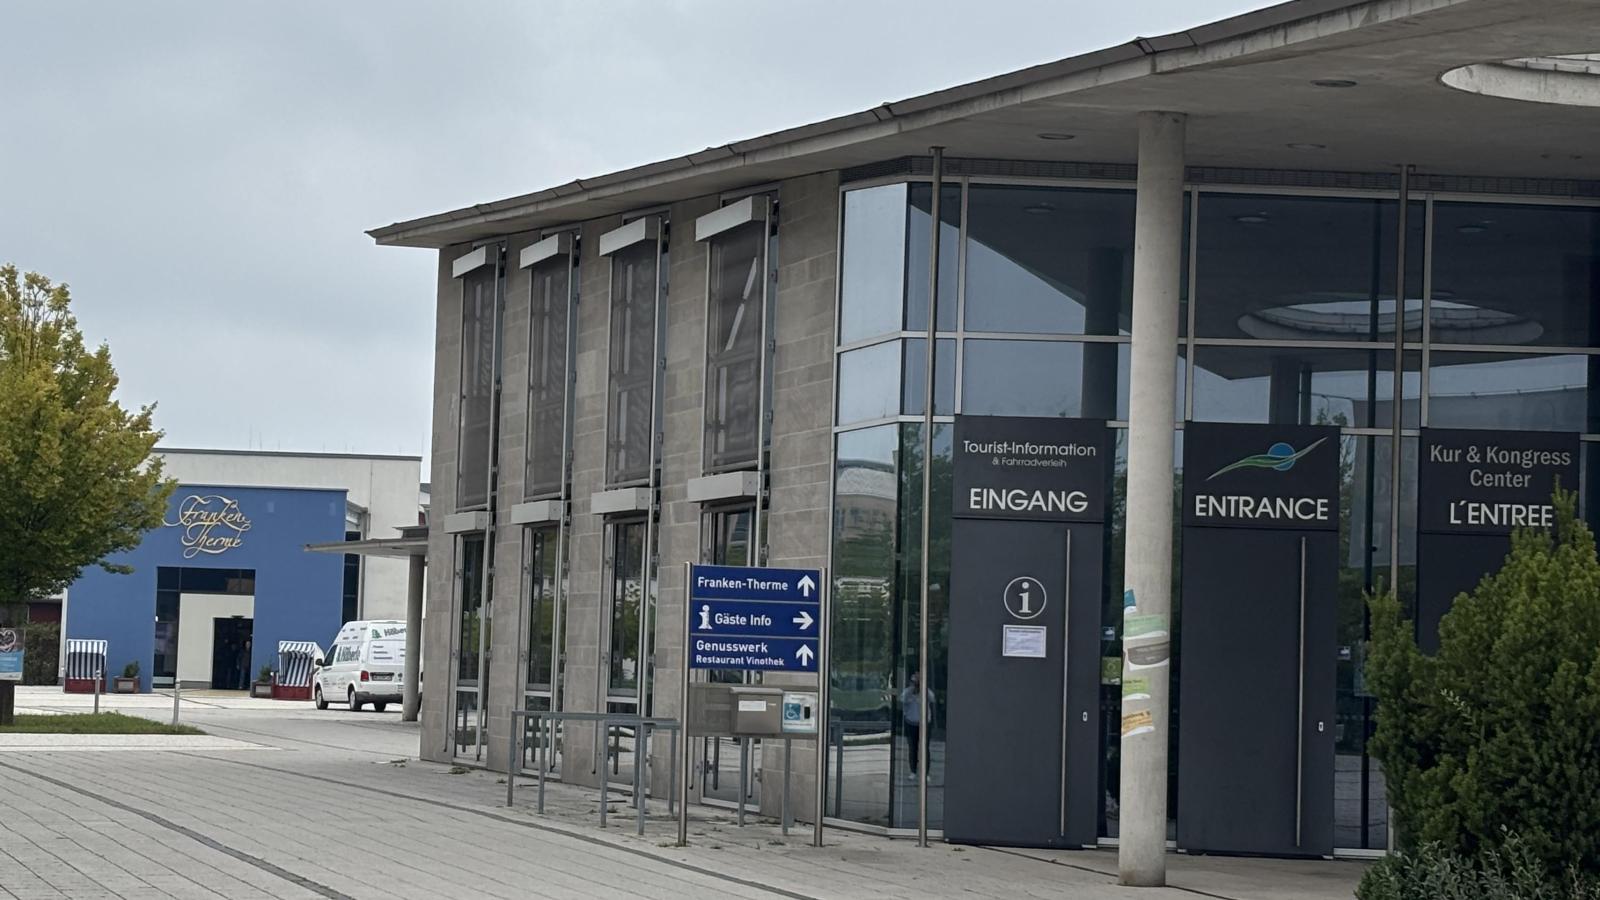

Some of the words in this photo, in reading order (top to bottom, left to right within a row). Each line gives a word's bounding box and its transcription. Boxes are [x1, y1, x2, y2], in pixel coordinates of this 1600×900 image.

[963, 440, 1096, 457] Tourist-Information
[1430, 444, 1462, 463] Kur
[1466, 445, 1481, 463] &
[1486, 446, 1571, 469] Kongress
[991, 456, 999, 466] &
[1001, 457, 1067, 468] Fahrradverleih
[1470, 469, 1532, 488] Center
[969, 487, 1089, 513] EINGANG
[1195, 495, 1329, 521] ENTRANCE
[161, 495, 251, 531] Franken
[182, 521, 243, 558] Therme
[697, 576, 789, 591] Franken-Therme
[714, 612, 748, 625] Gäste
[750, 614, 773, 627] Info
[696, 639, 768, 654] Genusswerk
[695, 654, 744, 665] Restaurant
[745, 656, 785, 667] Vinothek
